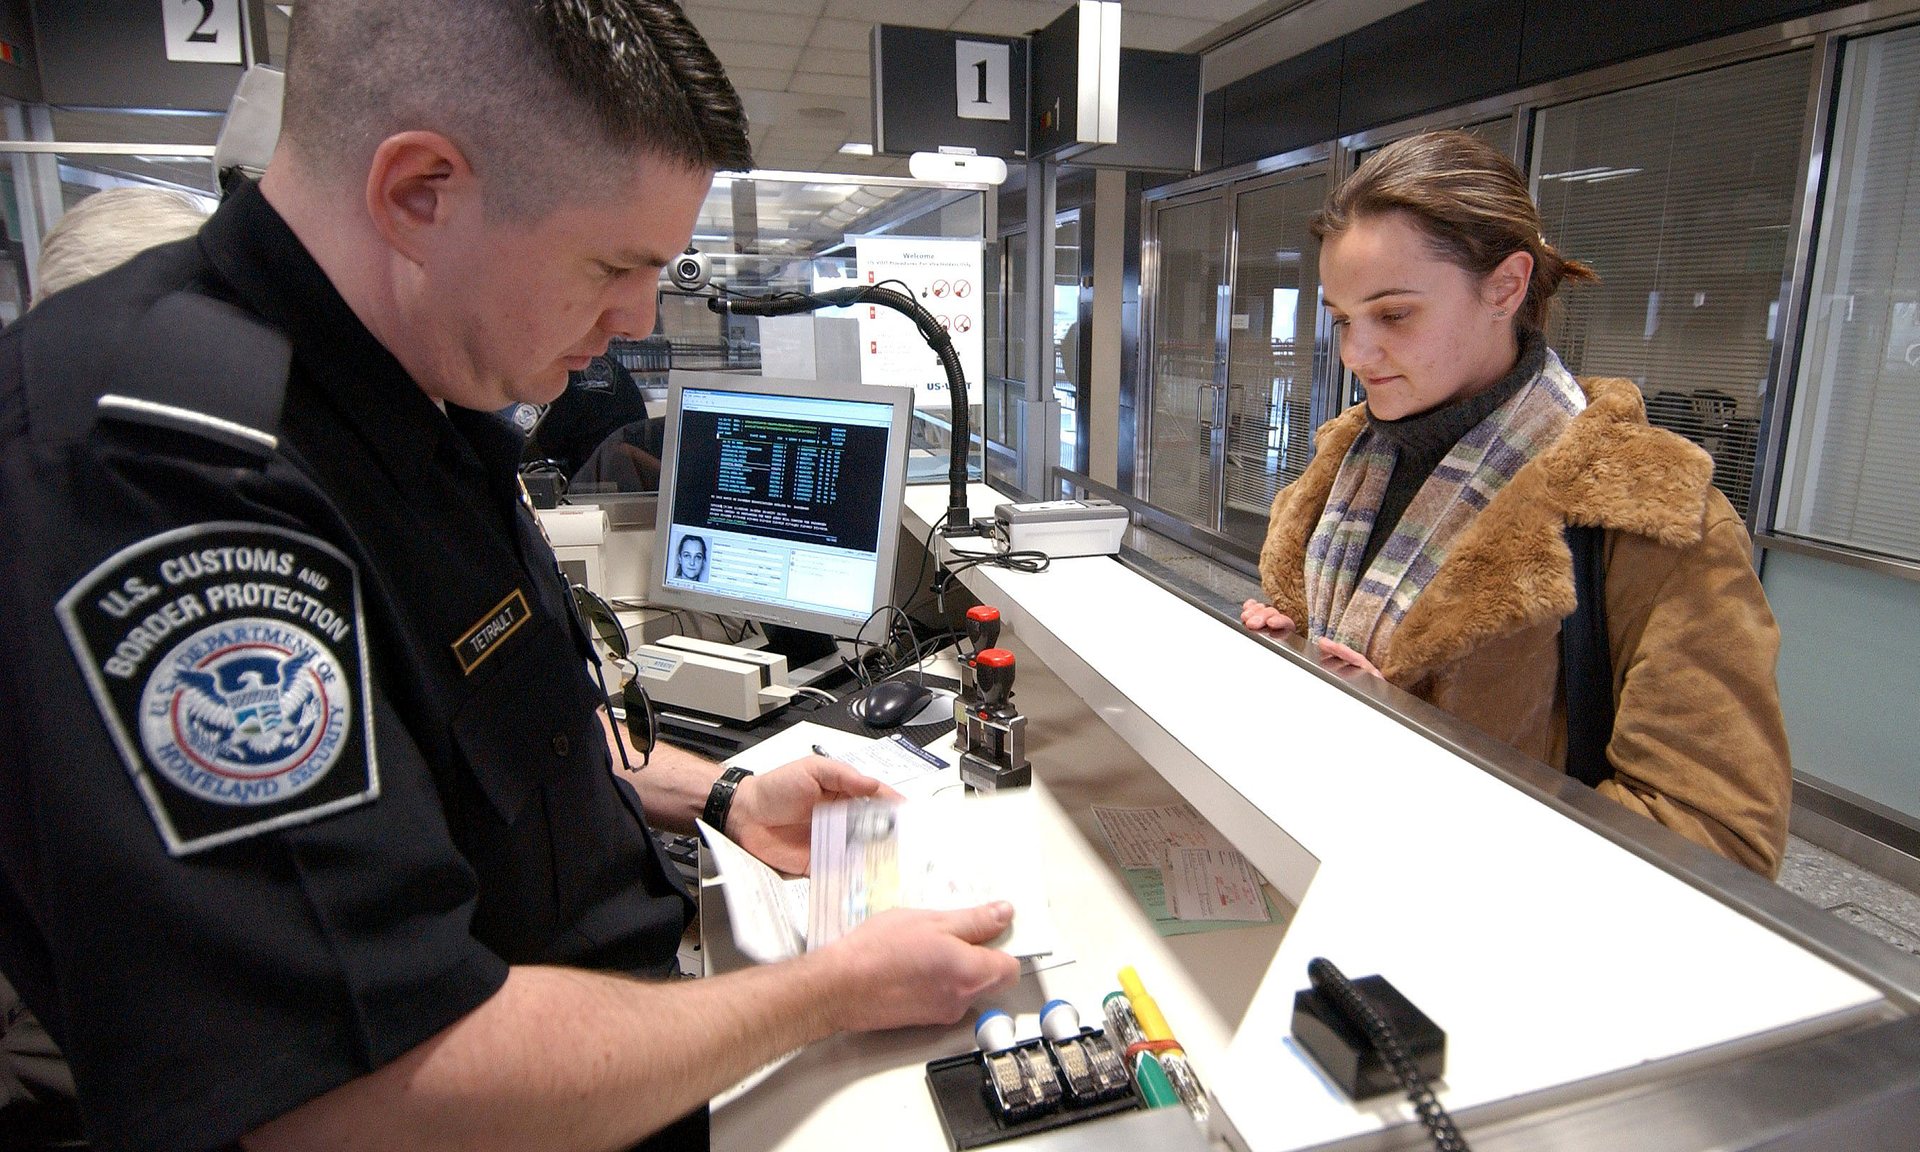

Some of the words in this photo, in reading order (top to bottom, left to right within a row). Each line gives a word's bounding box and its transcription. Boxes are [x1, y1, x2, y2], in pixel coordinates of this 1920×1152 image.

[185, 0, 218, 43] 2
[971, 59, 992, 104] 1
[902, 251, 935, 260] Welcome
[926, 382, 972, 391] US-VT
[99, 577, 160, 617] U.S.
[160, 548, 295, 584] CUSTOMS
[298, 567, 330, 592] AND
[103, 594, 207, 679] BORDER
[206, 583, 350, 643] PROTECTION
[469, 607, 515, 653] TETRAULT
[176, 626, 320, 673] DEPARTMENT
[318, 661, 337, 684] OF
[159, 742, 279, 800] HOMELAND
[288, 704, 344, 788] SECURITY
